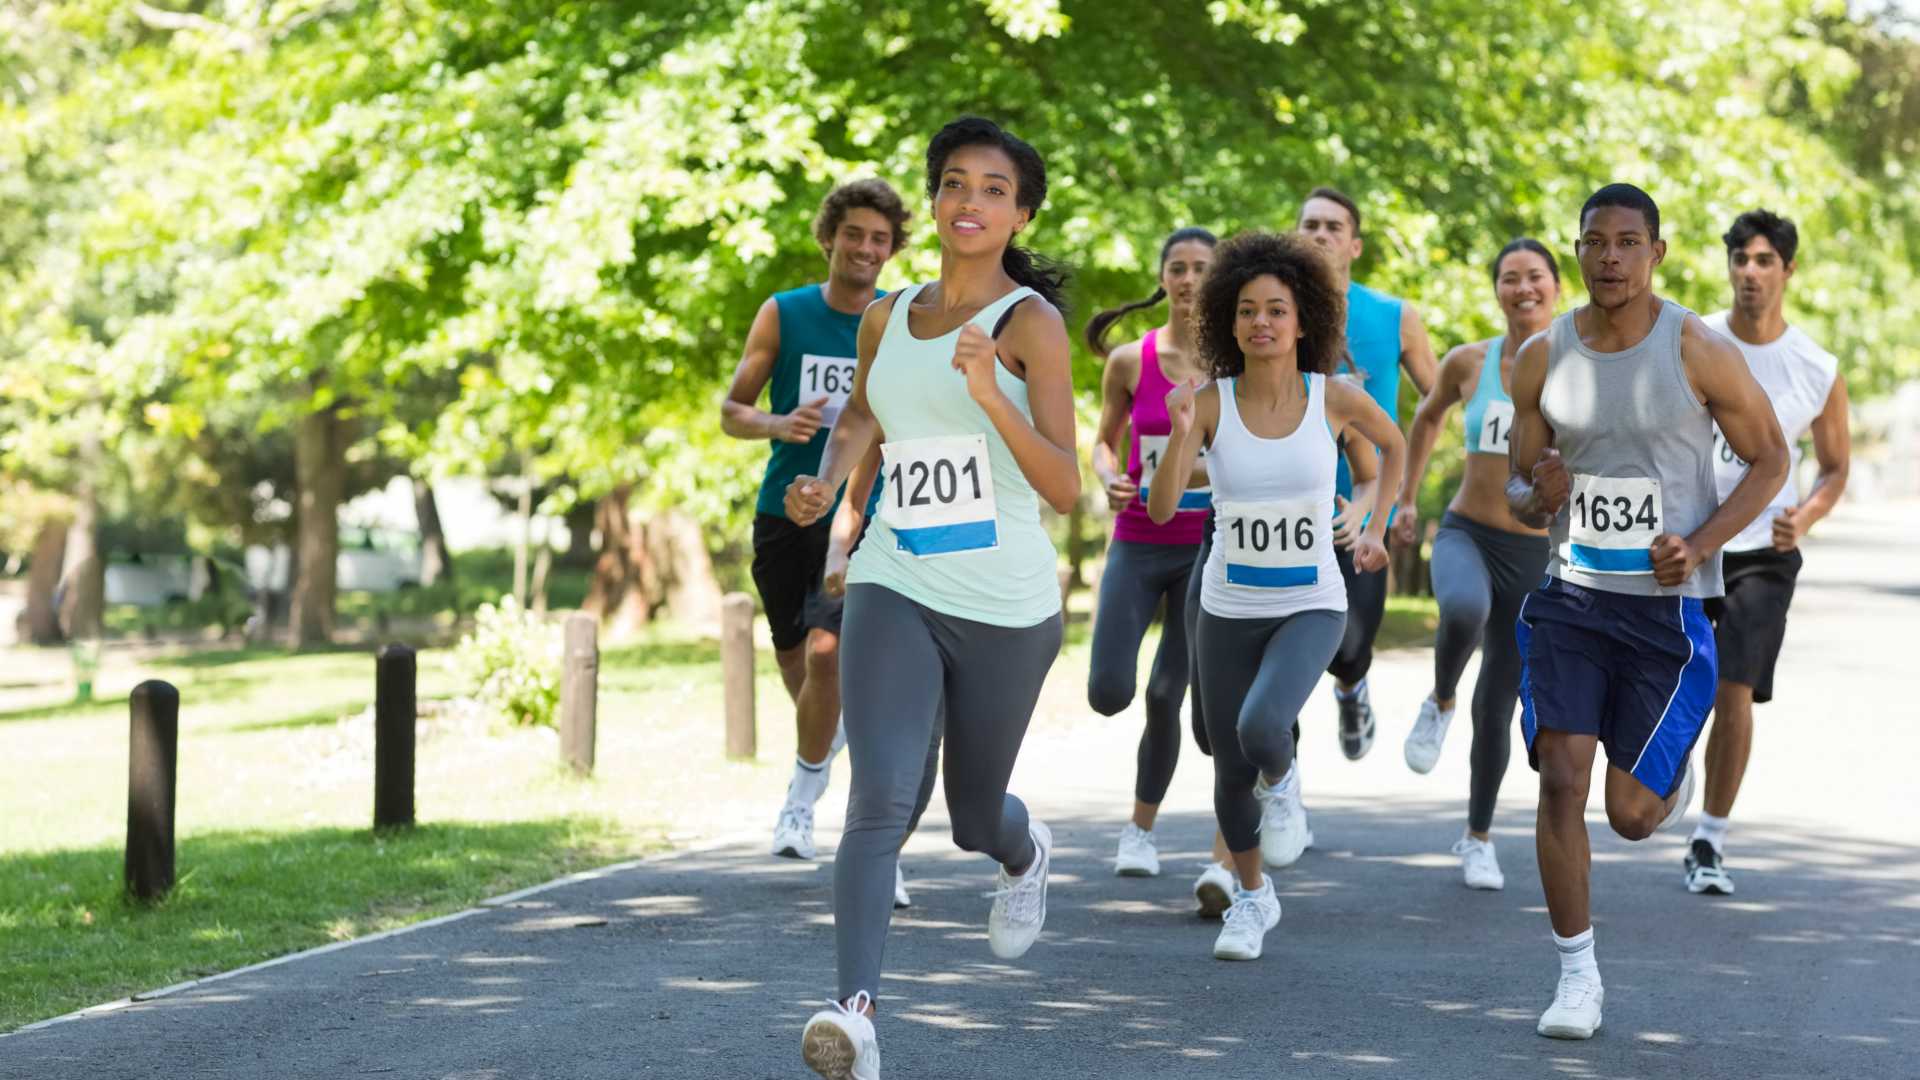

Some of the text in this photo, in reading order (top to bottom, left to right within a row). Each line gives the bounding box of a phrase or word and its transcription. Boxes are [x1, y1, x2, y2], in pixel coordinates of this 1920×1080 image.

[806, 362, 856, 394] 163
[890, 456, 982, 508] 1201
[1575, 491, 1658, 532] 1634
[1231, 517, 1314, 552] 1016
